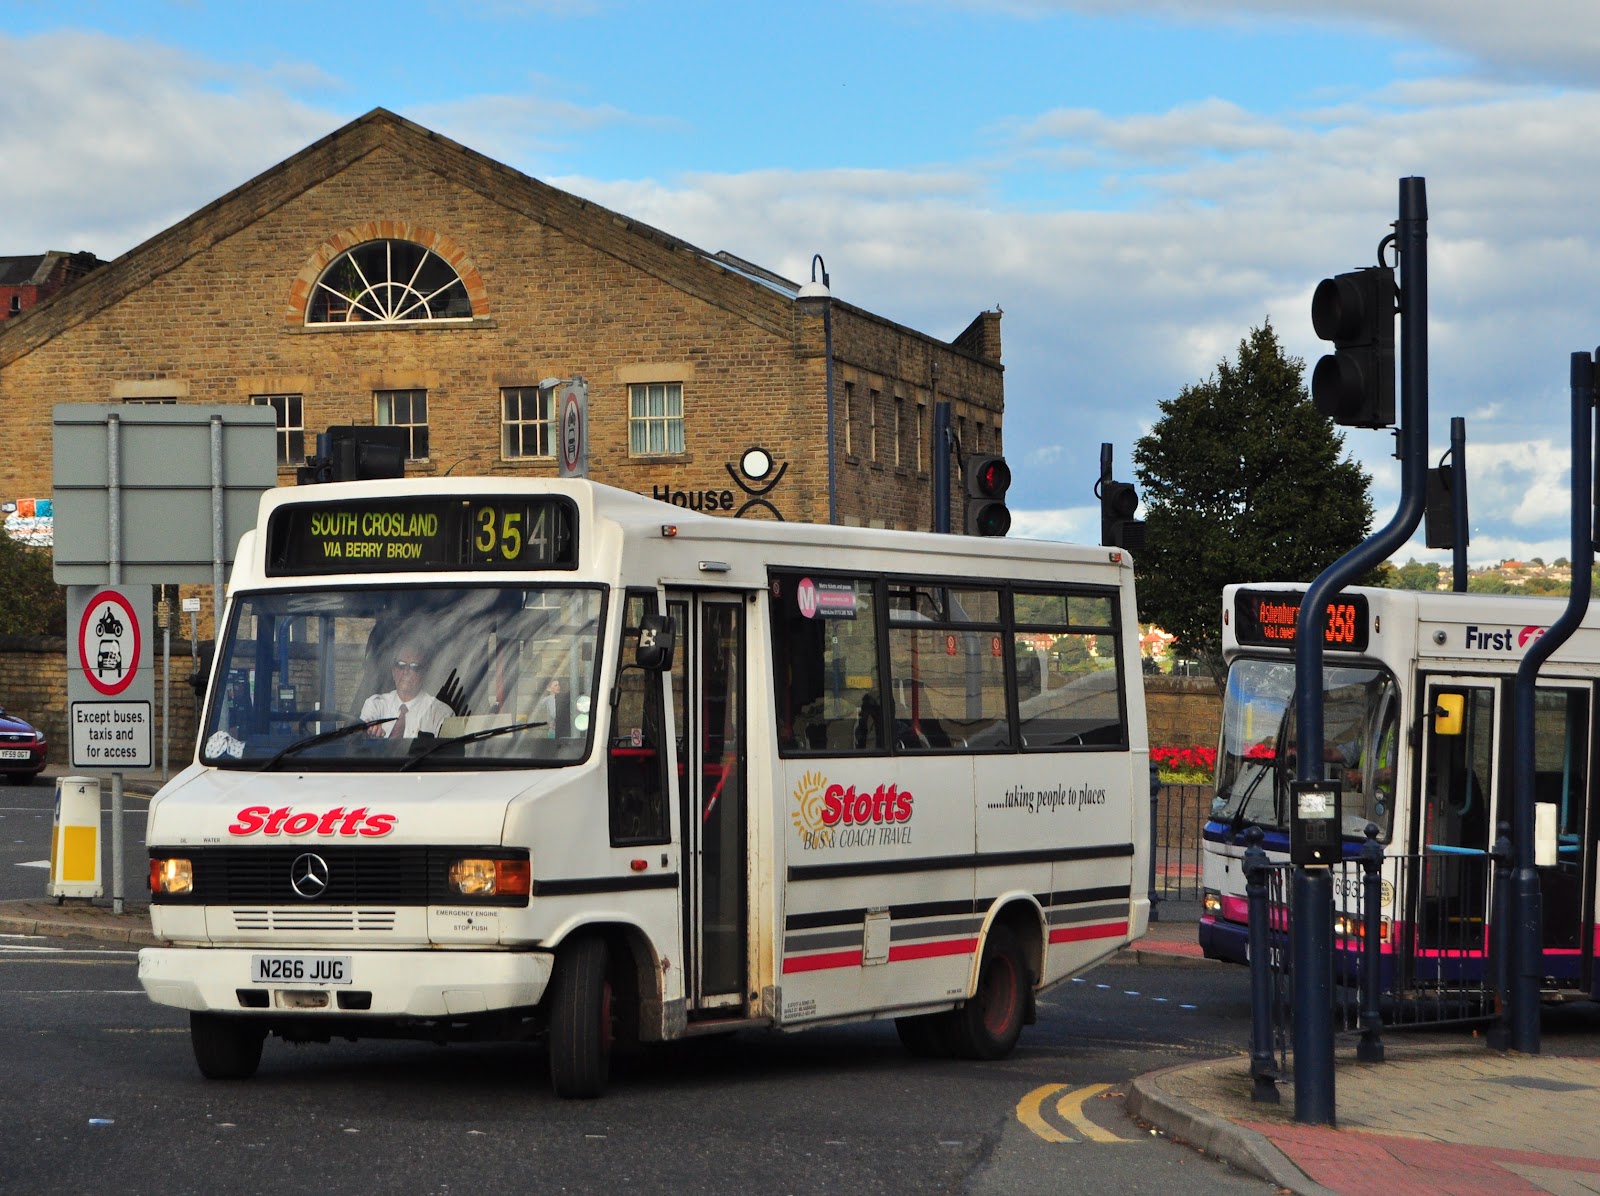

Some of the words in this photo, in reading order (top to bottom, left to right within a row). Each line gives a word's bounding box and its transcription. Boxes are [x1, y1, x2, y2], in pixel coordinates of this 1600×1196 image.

[653, 484, 734, 511] House
[311, 512, 358, 536] SOUTH
[362, 512, 438, 537] CROSLAND
[475, 506, 548, 560] 354
[323, 541, 342, 558] VIA
[345, 542, 384, 559] BERRY
[386, 542, 423, 559] BROW
[799, 586, 815, 610] M
[1325, 603, 1356, 642] 358
[1465, 625, 1513, 651] First
[77, 710, 111, 725] Except
[113, 709, 145, 724] buses,
[89, 727, 113, 740] taxis
[115, 727, 134, 740] and
[86, 744, 101, 758] for
[104, 747, 137, 758] access
[78, 786, 86, 795] 4
[1036, 783, 1066, 814] people
[1068, 786, 1077, 806] to
[1078, 782, 1106, 812] places
[821, 783, 914, 827] Stotts
[228, 805, 398, 838] Stotts
[803, 831, 828, 850] BUS
[839, 828, 877, 848] COACH
[879, 826, 913, 846] TRAVEL
[260, 959, 304, 979] N266
[309, 960, 343, 980] JUG
